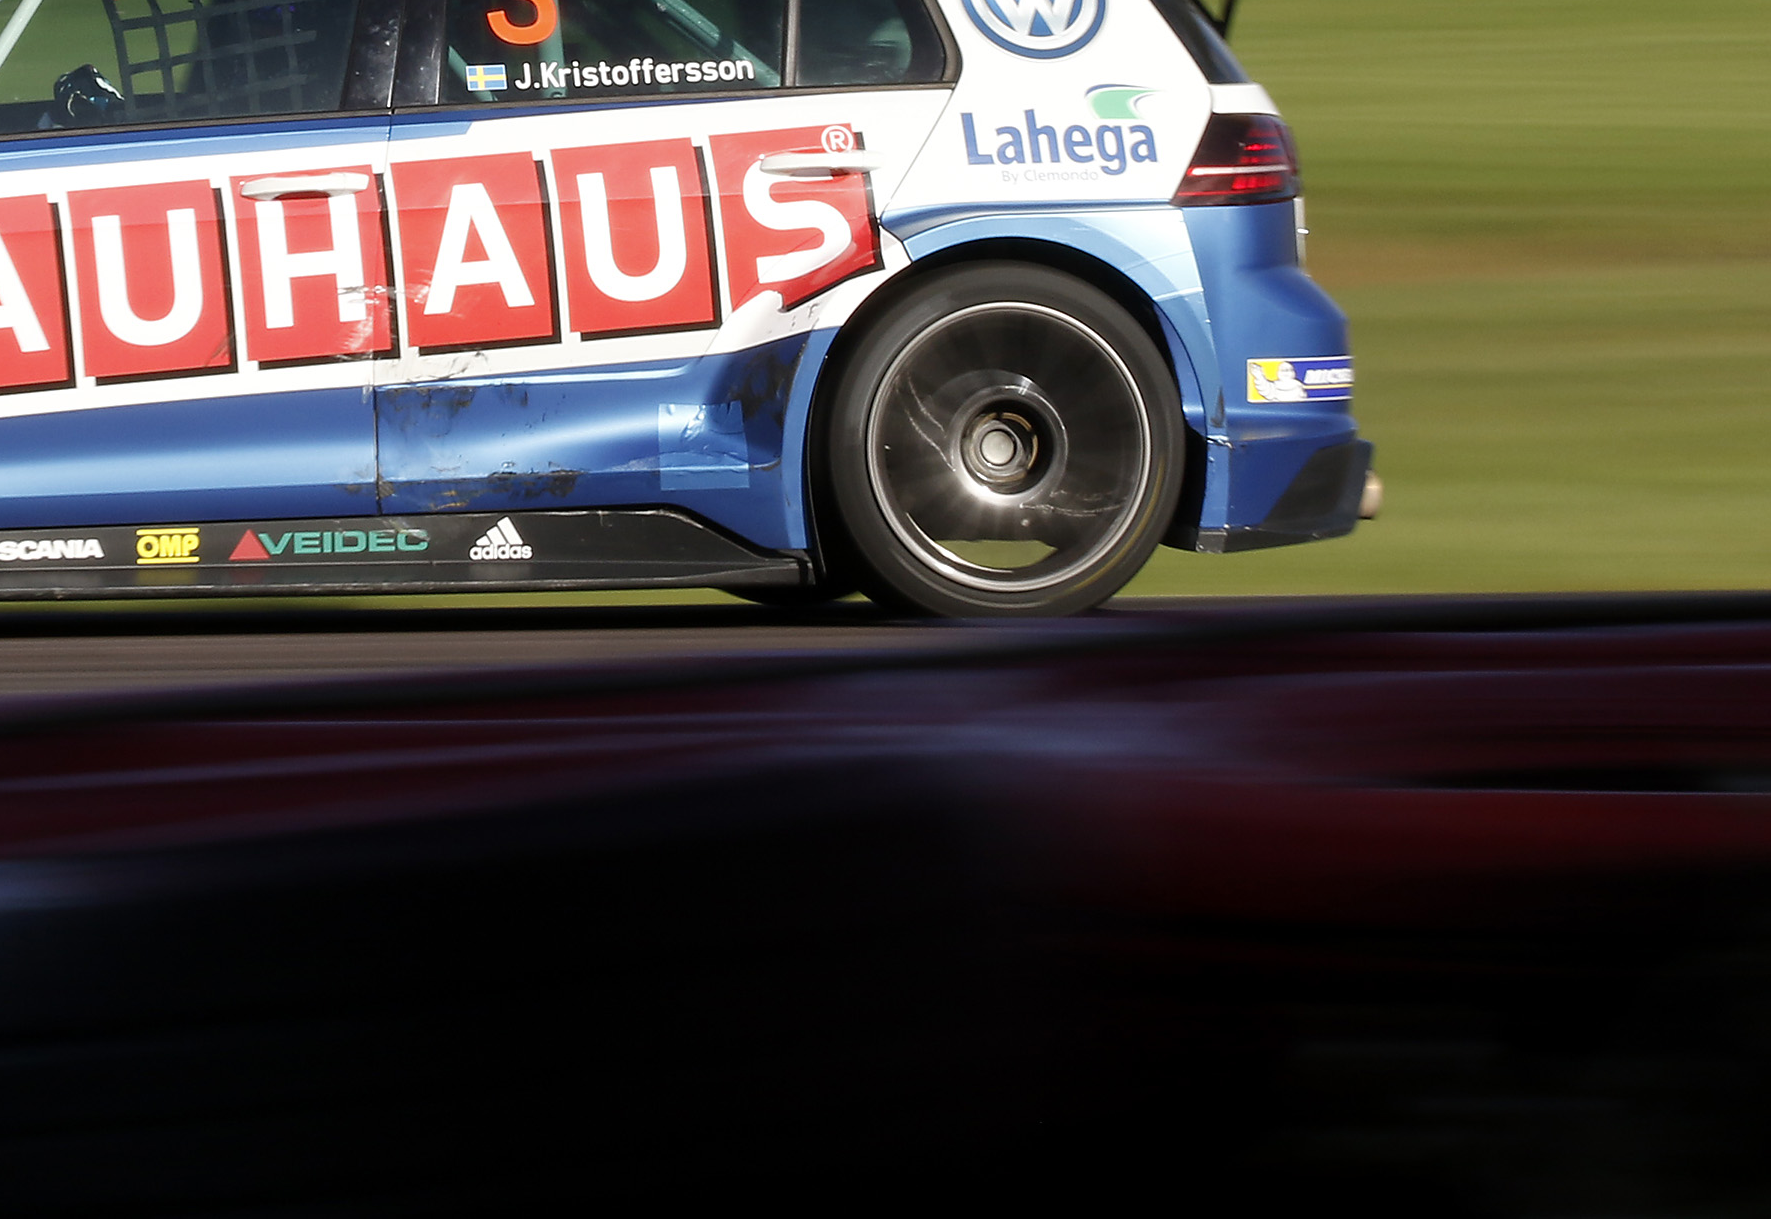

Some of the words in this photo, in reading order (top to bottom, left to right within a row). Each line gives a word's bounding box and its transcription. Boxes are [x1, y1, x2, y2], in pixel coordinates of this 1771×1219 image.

[514, 57, 755, 90] J.Kristoffersson
[960, 109, 1158, 175] Lahega
[1001, 170, 1018, 184] By
[1024, 168, 1099, 182] Clemondo
[136, 533, 200, 559] OMP
[258, 528, 429, 555] VEIDEC
[469, 543, 532, 560] adidas
